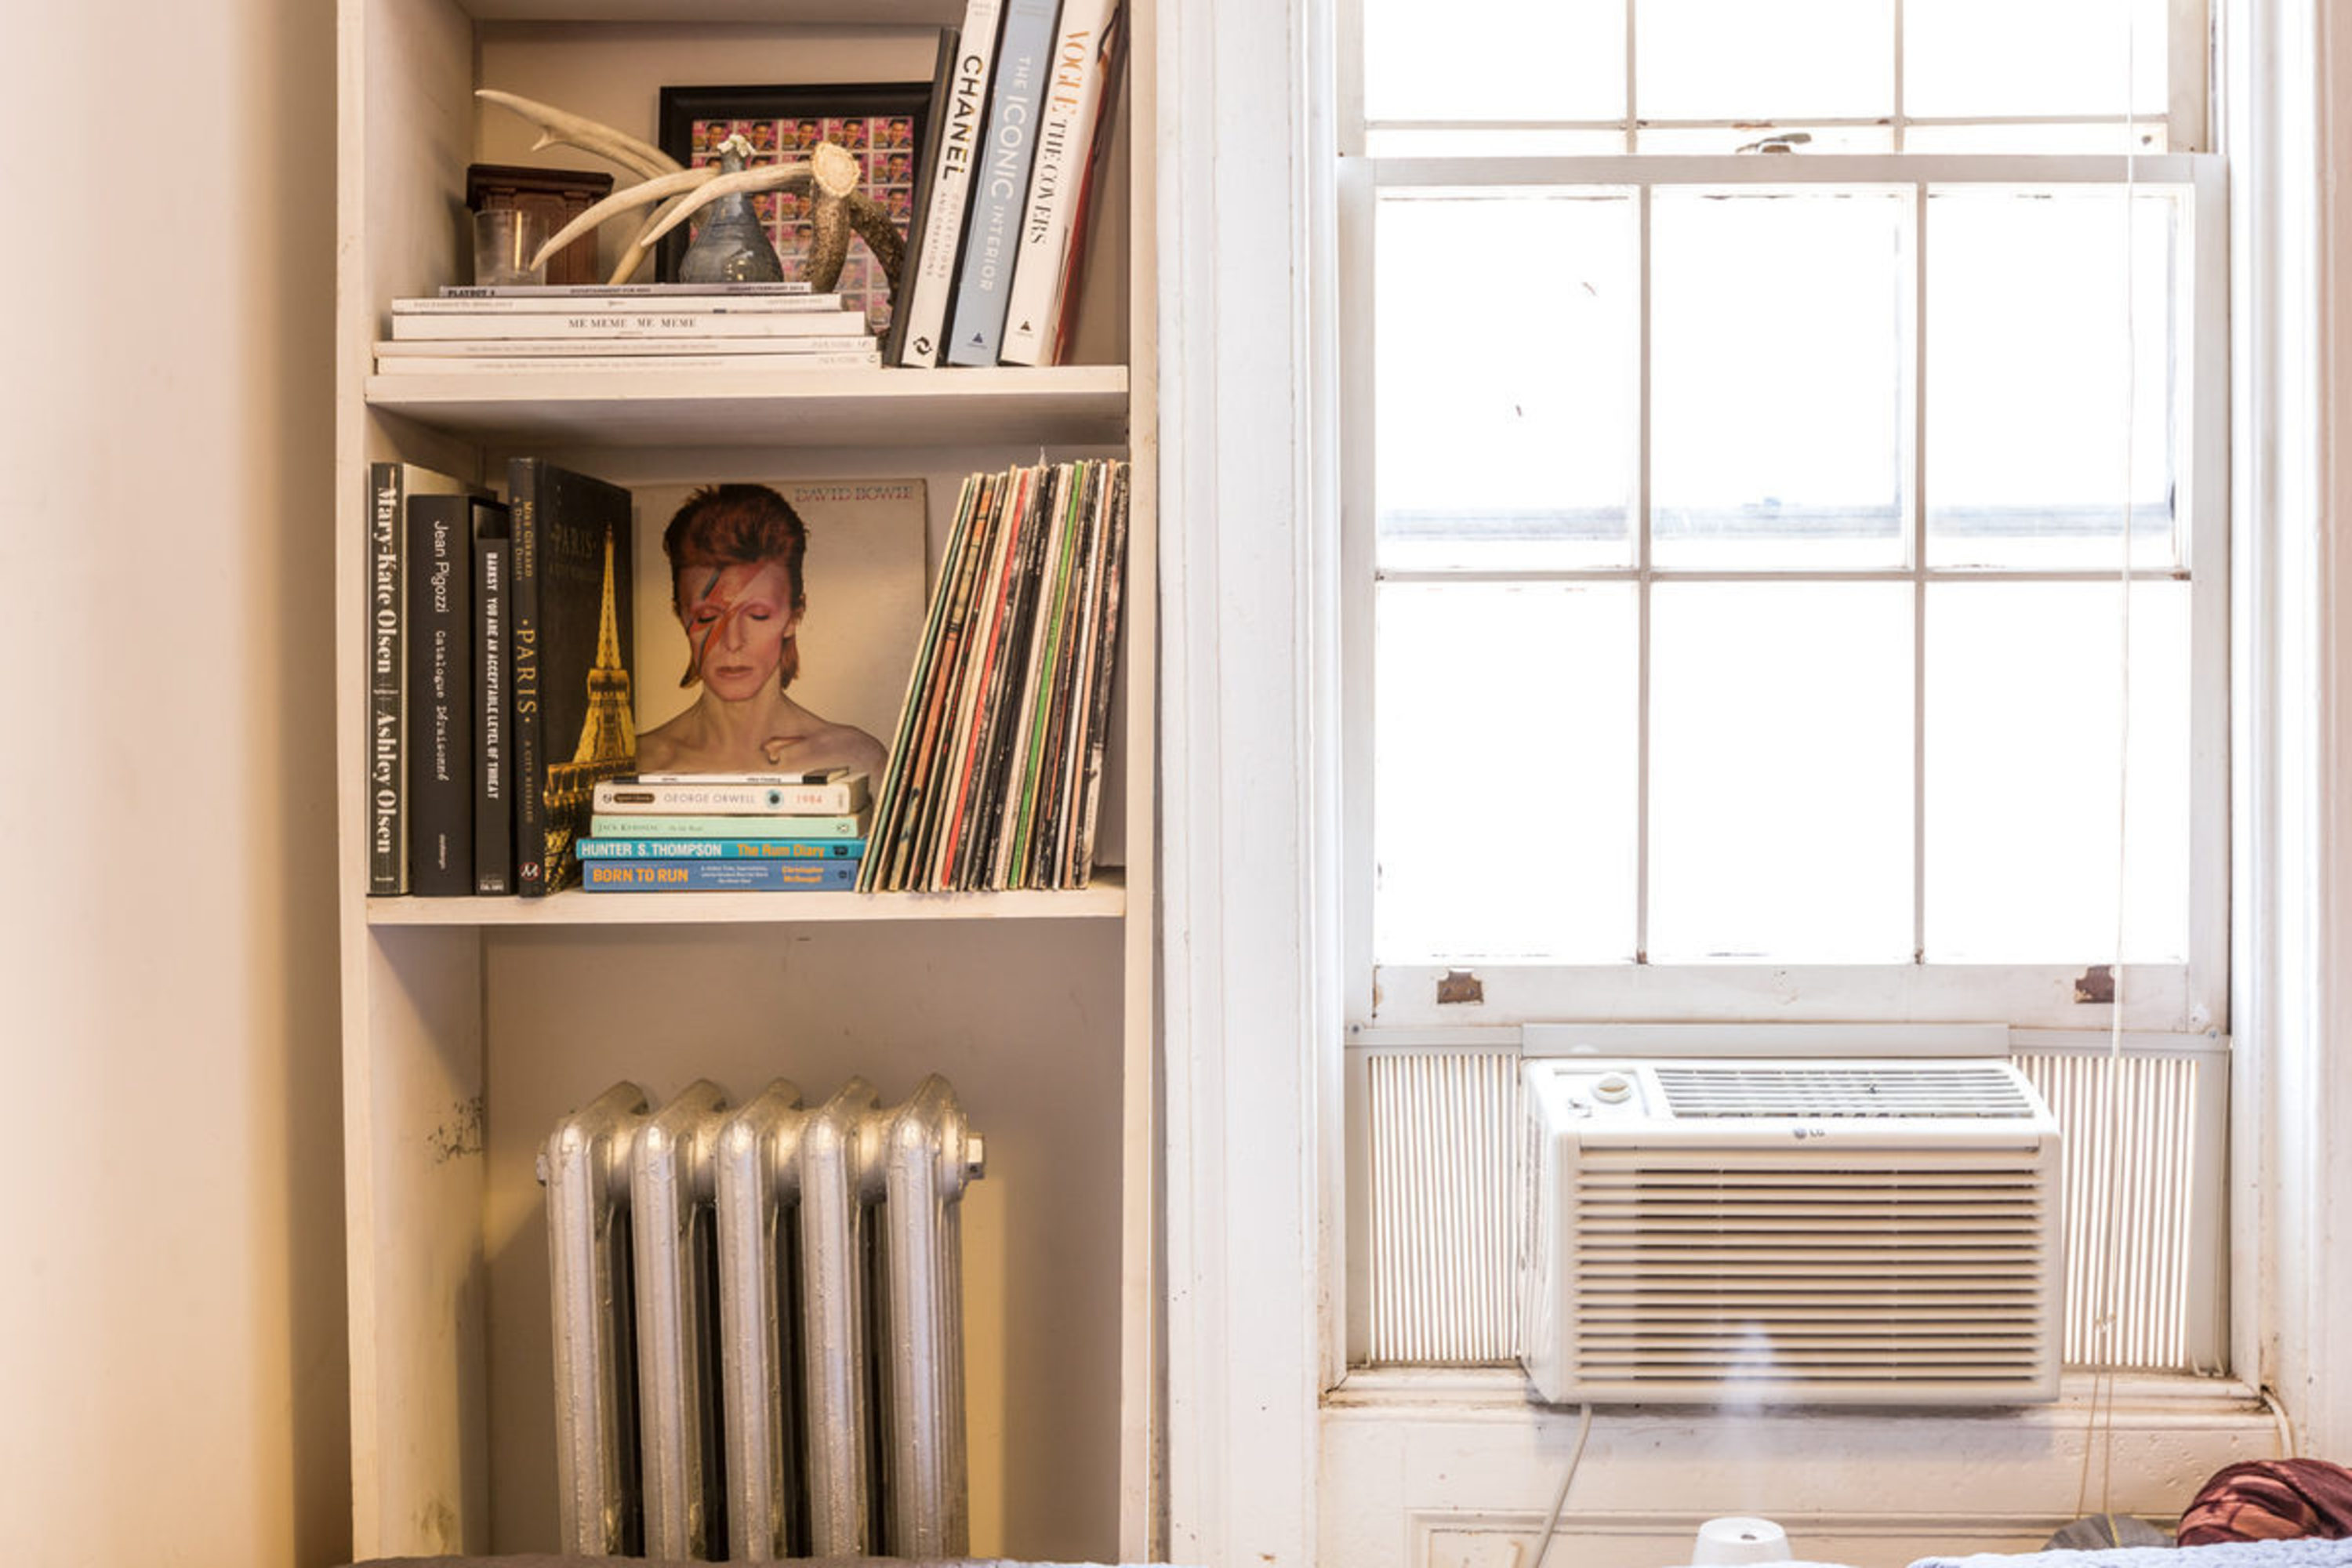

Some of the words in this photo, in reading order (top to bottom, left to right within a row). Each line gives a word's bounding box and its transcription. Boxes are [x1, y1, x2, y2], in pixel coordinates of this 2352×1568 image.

[1012, 56, 1032, 90] THE
[1051, 31, 1090, 116] VOGUE
[942, 54, 983, 180] CHANEL
[1044, 118, 1067, 162] THE
[990, 95, 1028, 200] ICONIC
[1030, 164, 1058, 245] COVERS
[979, 204, 1005, 292] INTERIOR
[448, 289, 486, 298] PLAYBOY
[794, 485, 851, 503] DAVID
[855, 485, 913, 501] BOWIE
[373, 487, 397, 605] Mary-Kate
[434, 521, 450, 558] Jean
[430, 561, 450, 613] Pigozzi
[376, 608, 397, 673] Olsen
[433, 630, 446, 699] Catalogue
[372, 710, 397, 786] Ashley
[376, 789, 397, 854] Olsen
[664, 793, 709, 804] GEORGE
[713, 793, 755, 804] ORWELL
[796, 793, 822, 804] 1984
[581, 843, 633, 856] HUNTER
[637, 843, 649, 856] S.
[651, 843, 722, 857] THOMPSON
[593, 868, 633, 883] BORN
[635, 868, 655, 883] TO
[657, 868, 689, 883] RUN
[736, 844, 759, 857] The
[761, 844, 790, 857] Rum
[793, 844, 826, 859] Diary
